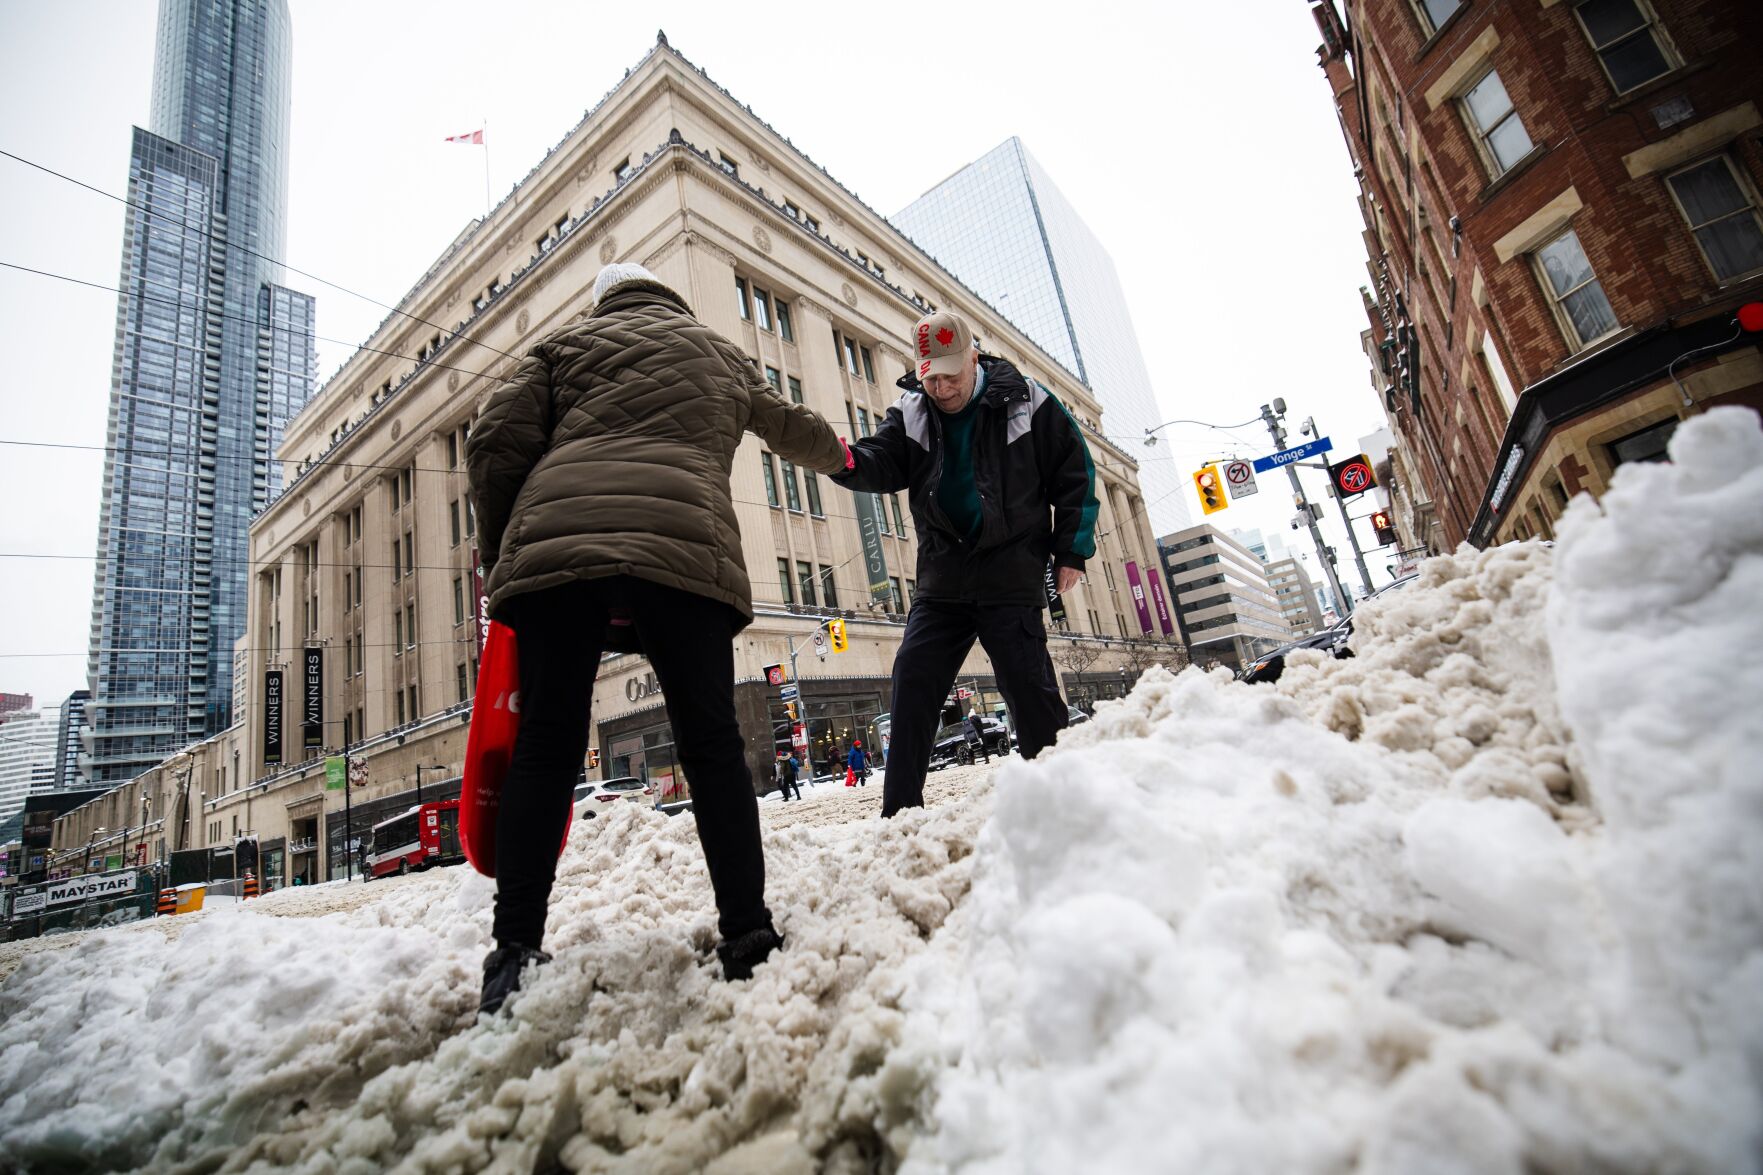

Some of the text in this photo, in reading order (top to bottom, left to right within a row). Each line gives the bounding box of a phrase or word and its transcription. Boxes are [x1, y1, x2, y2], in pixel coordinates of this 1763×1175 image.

[1270, 448, 1305, 465] Yonge
[863, 516, 882, 573] CARLU
[268, 677, 280, 745] WINNERS
[308, 655, 320, 724] WINNERS
[51, 879, 129, 900] MAYSTAR
